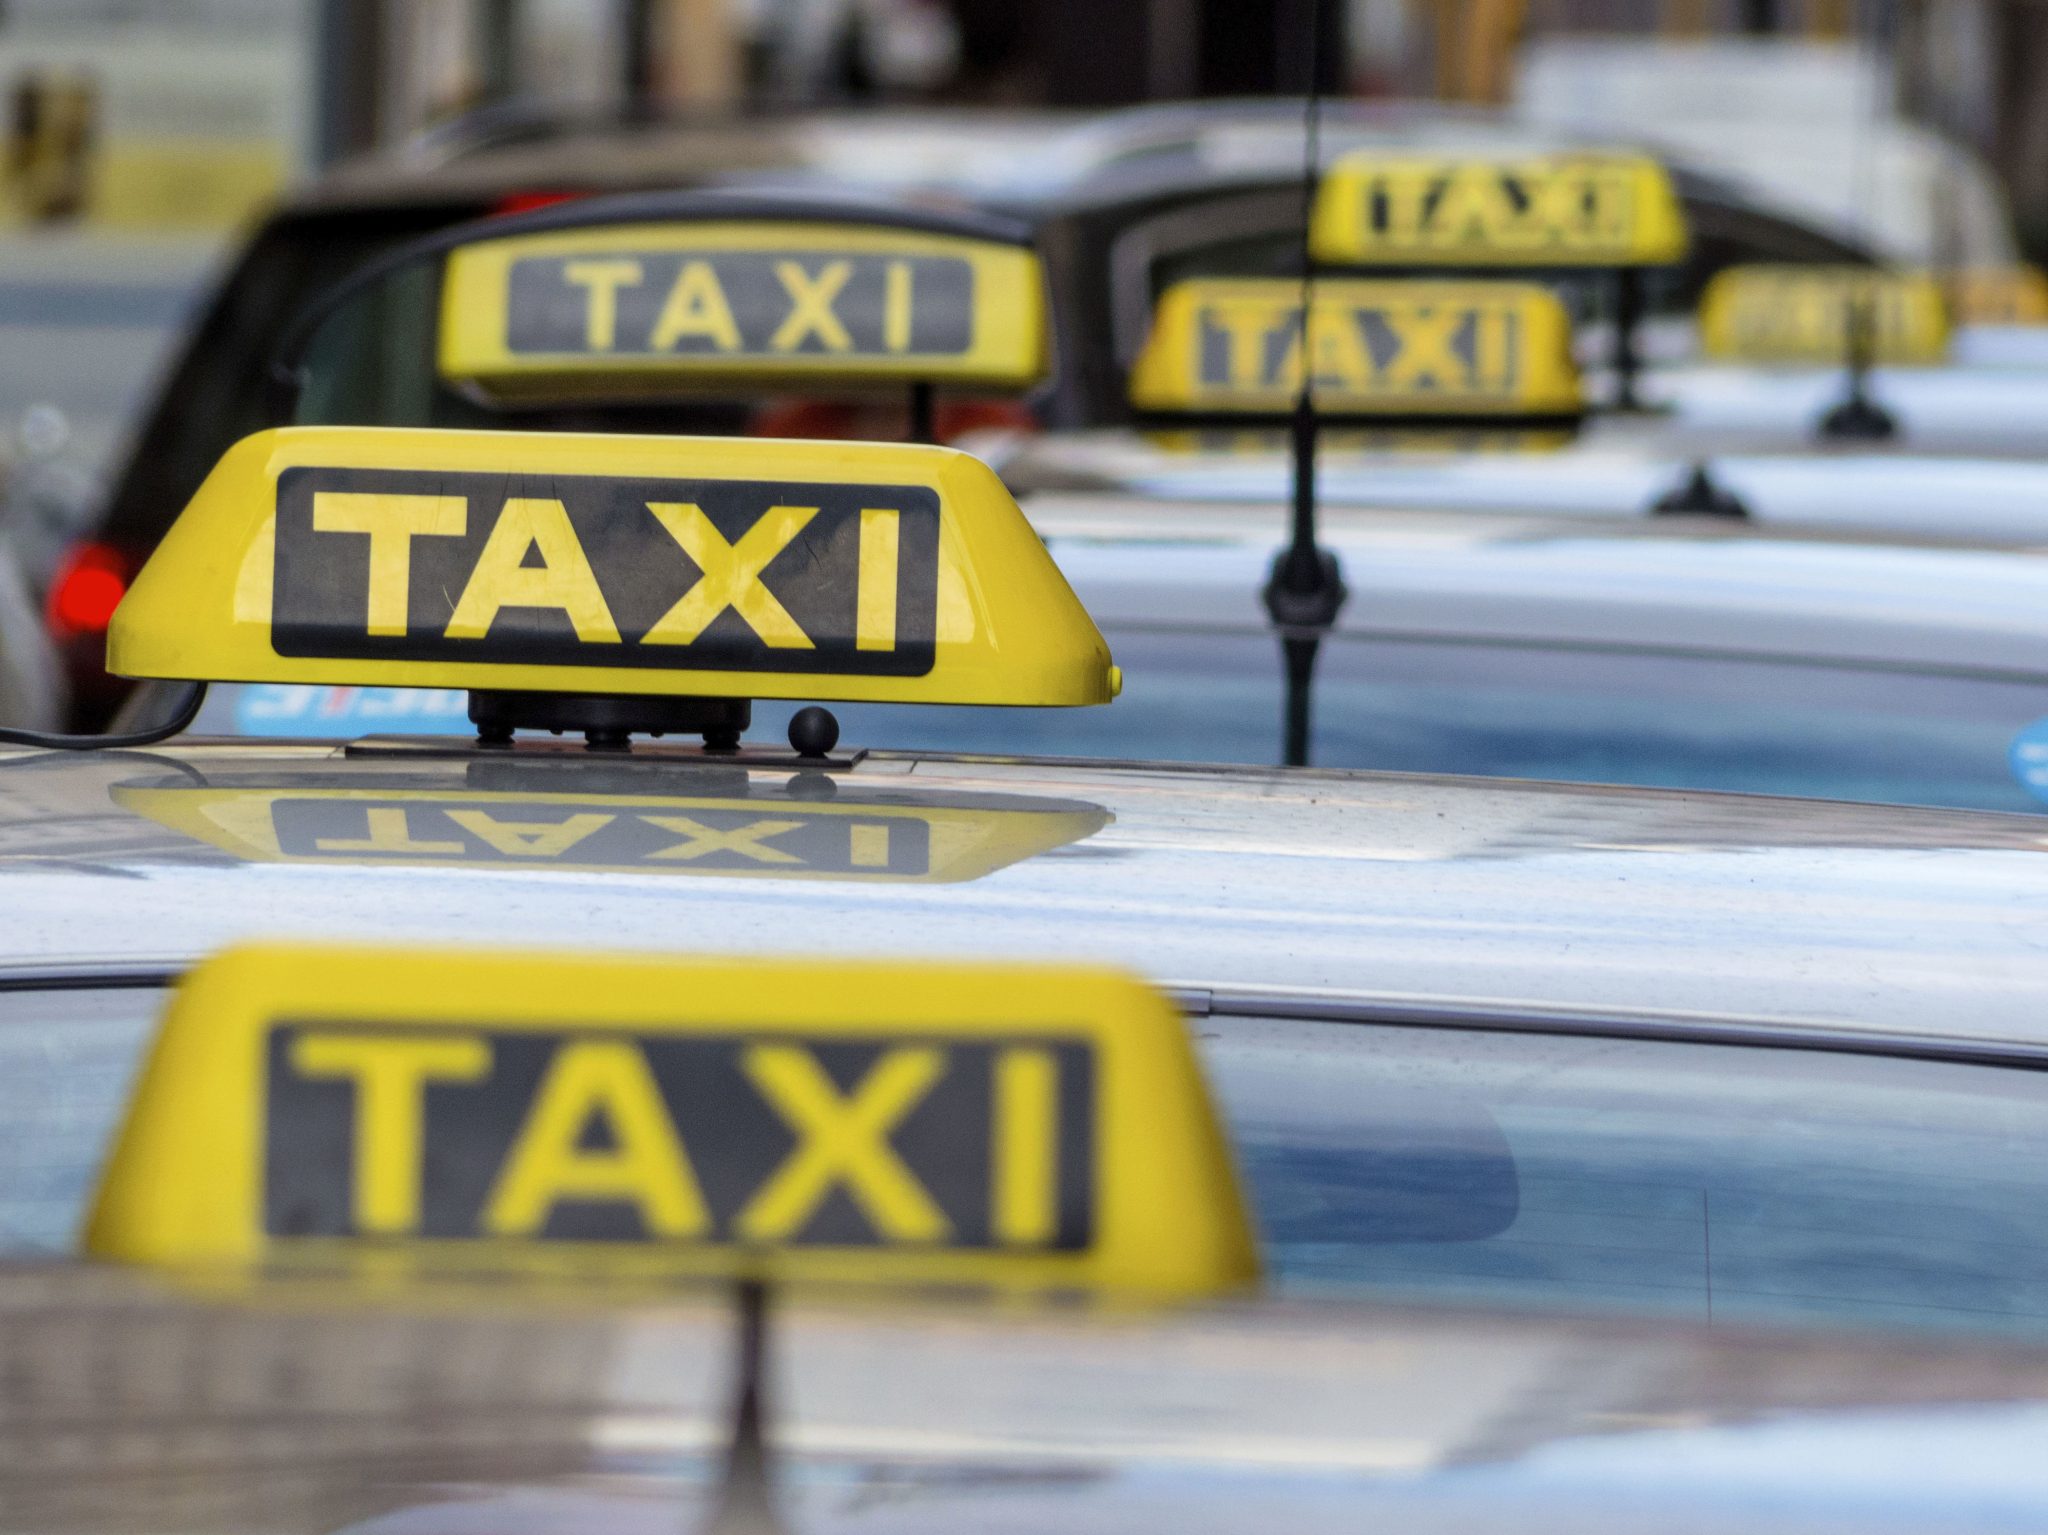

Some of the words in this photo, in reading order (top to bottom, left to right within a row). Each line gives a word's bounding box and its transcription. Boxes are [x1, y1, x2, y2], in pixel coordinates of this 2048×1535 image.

[566, 260, 914, 352] TAXI
[1210, 306, 1510, 394] TAXI
[312, 492, 902, 652] TAXI
[290, 1035, 1058, 1244] TAXI
